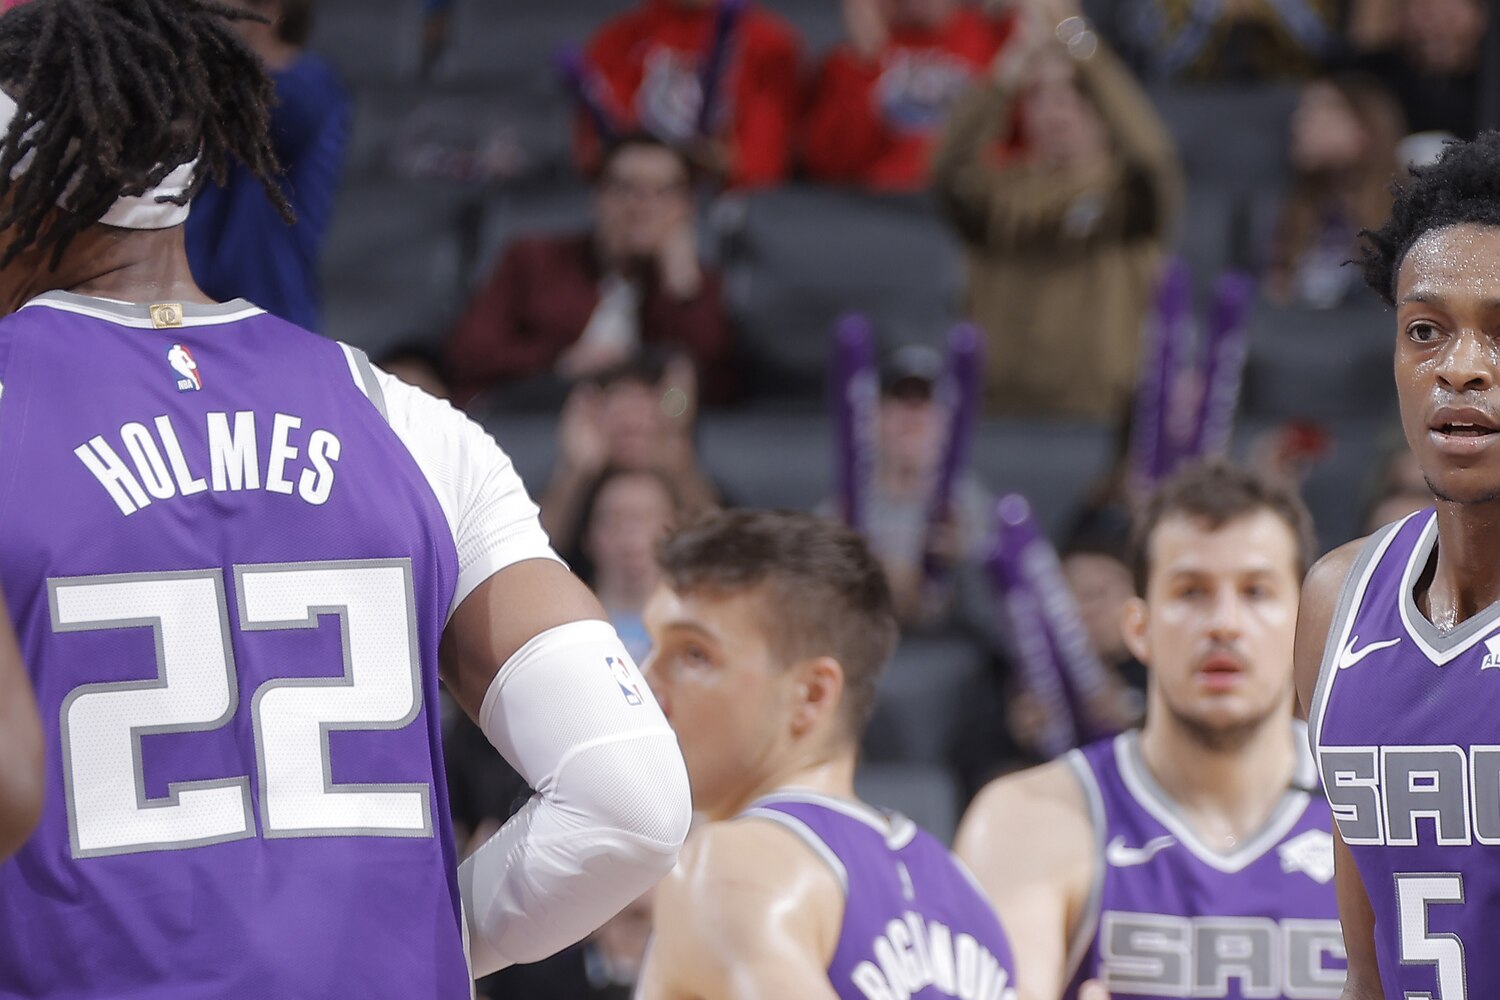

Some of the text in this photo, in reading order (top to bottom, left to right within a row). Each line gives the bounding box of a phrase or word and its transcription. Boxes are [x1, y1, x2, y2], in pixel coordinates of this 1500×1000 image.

[73, 410, 342, 517] HOLMES
[46, 557, 434, 859] 22
[1101, 910, 1347, 1000] SAC
